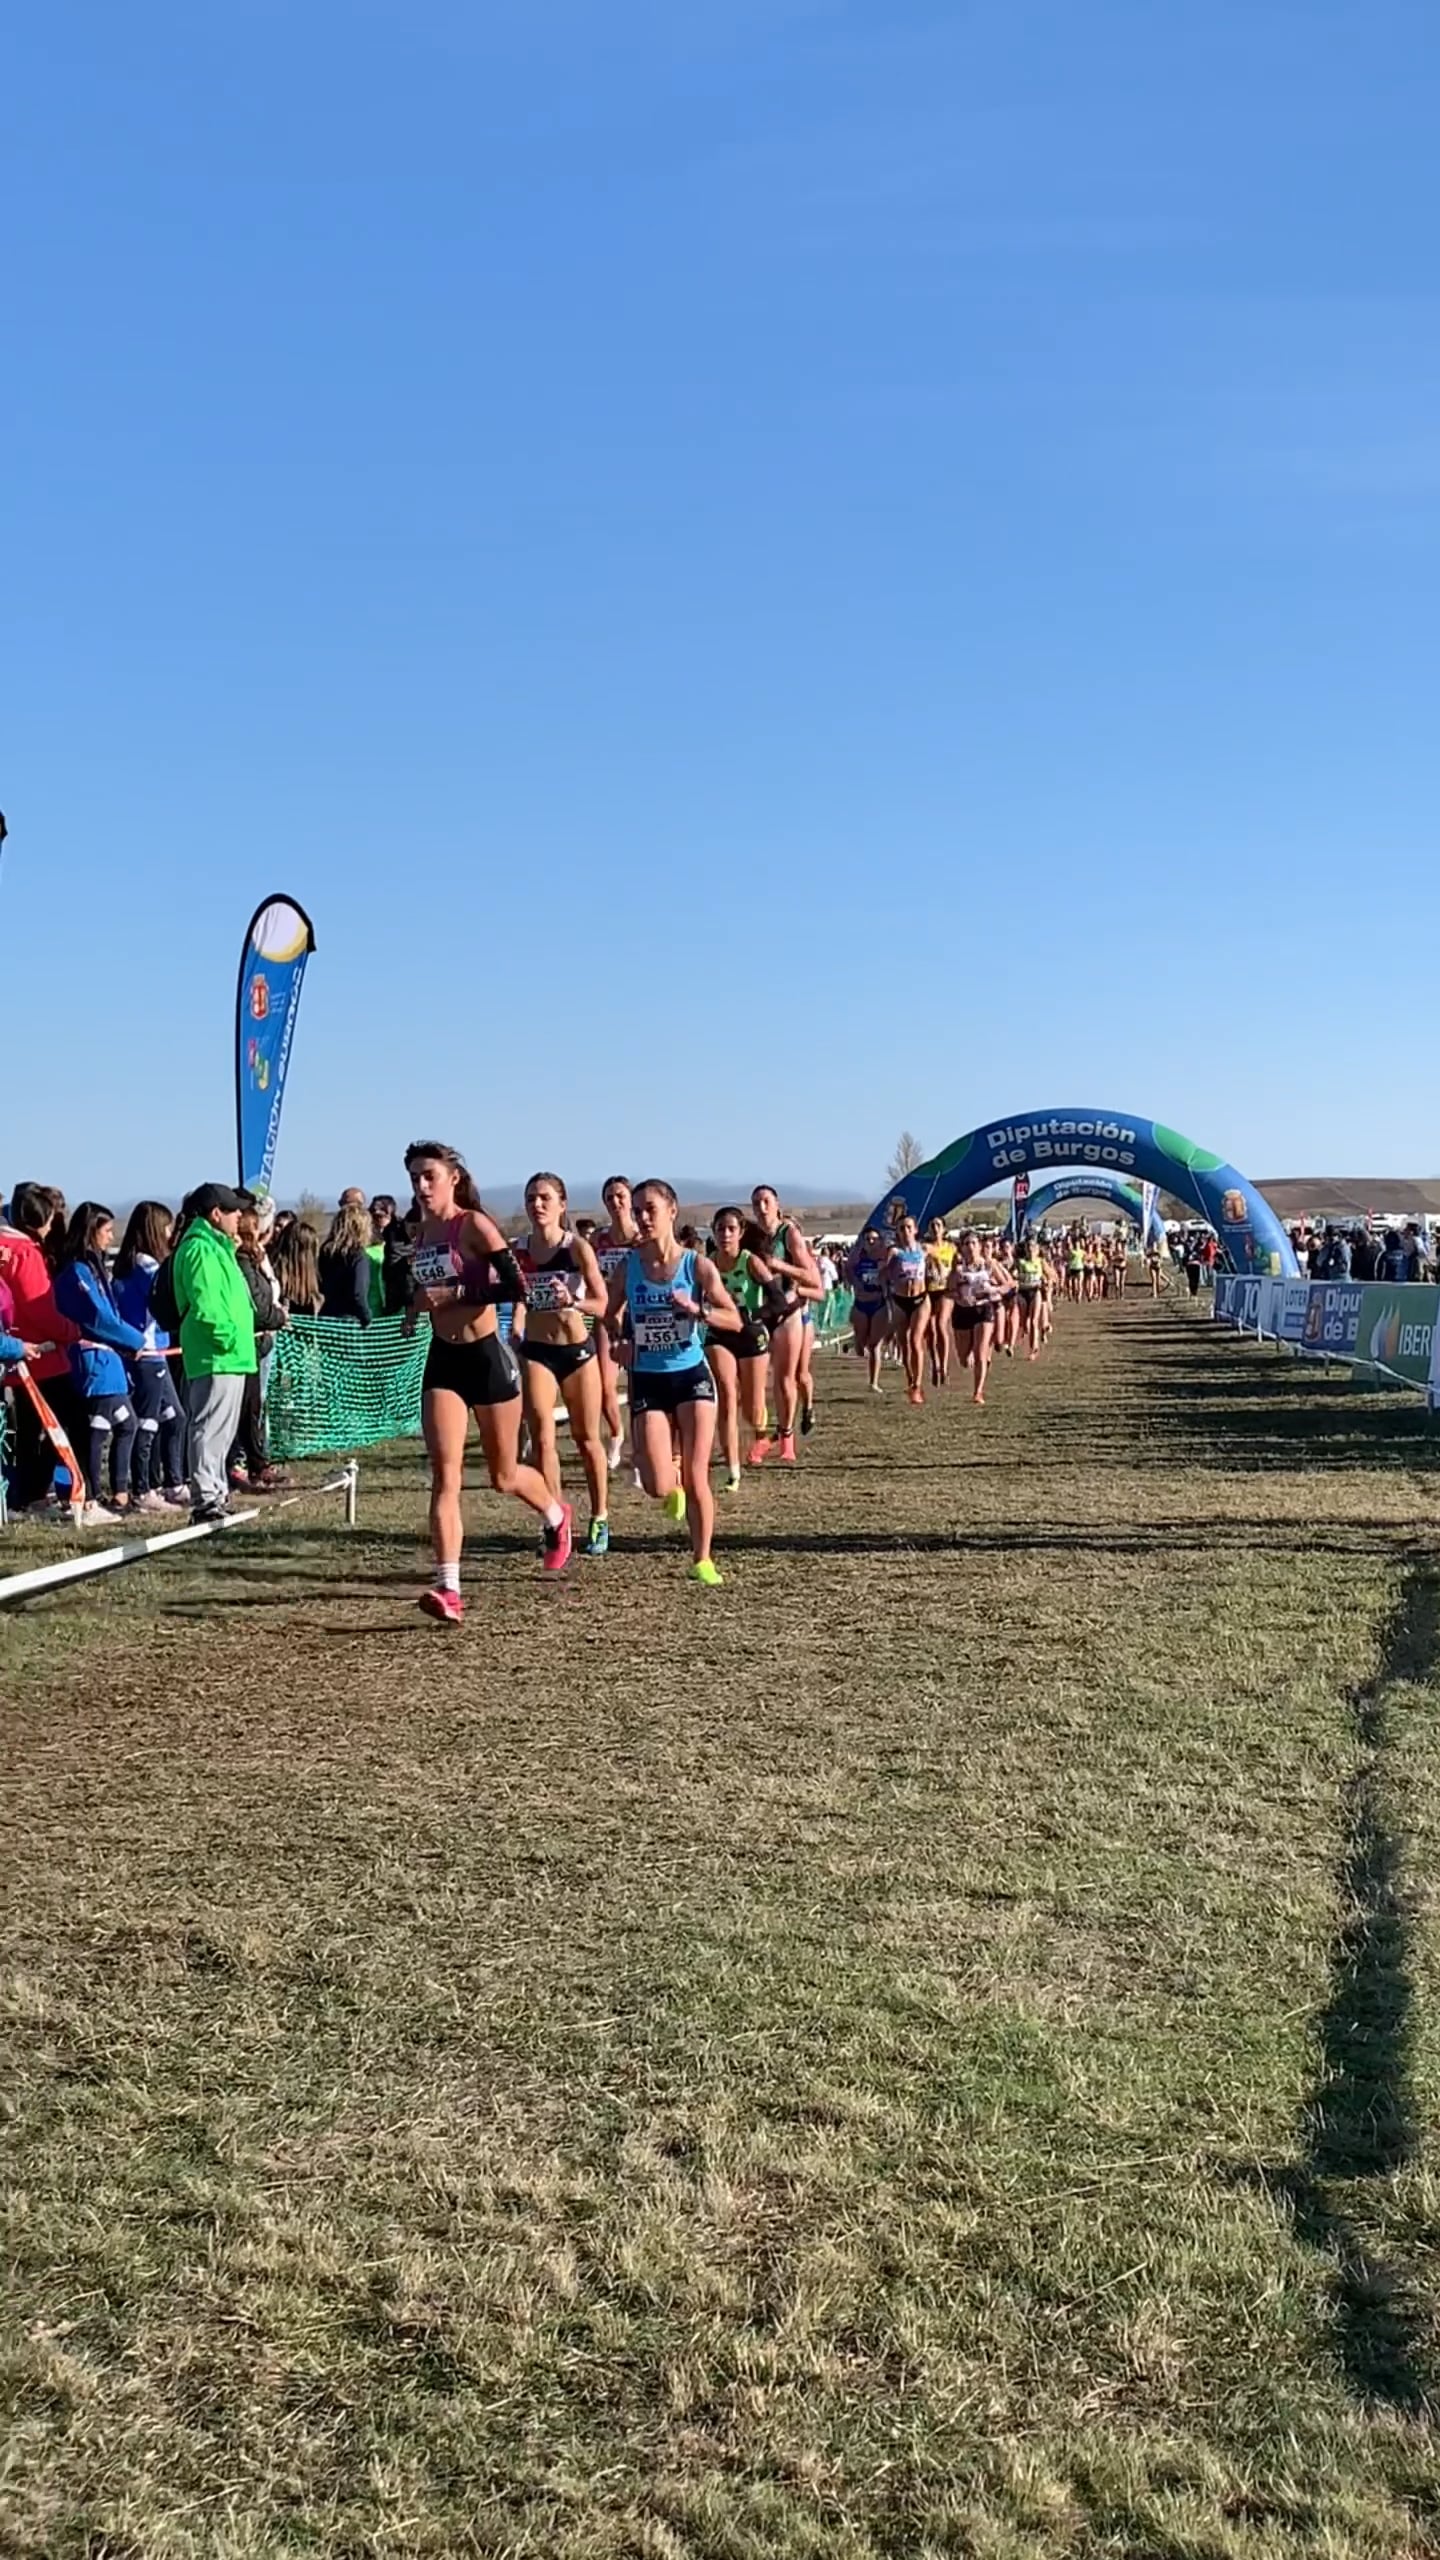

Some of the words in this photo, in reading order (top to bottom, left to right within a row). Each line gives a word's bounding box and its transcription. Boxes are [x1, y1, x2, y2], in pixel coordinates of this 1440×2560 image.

[987, 1119, 1136, 1149] Diputación
[992, 1149, 1027, 1168] de
[1033, 1141, 1136, 1166] Burgos
[644, 1331, 681, 1343] 1561
[1324, 1316, 1344, 1341] de
